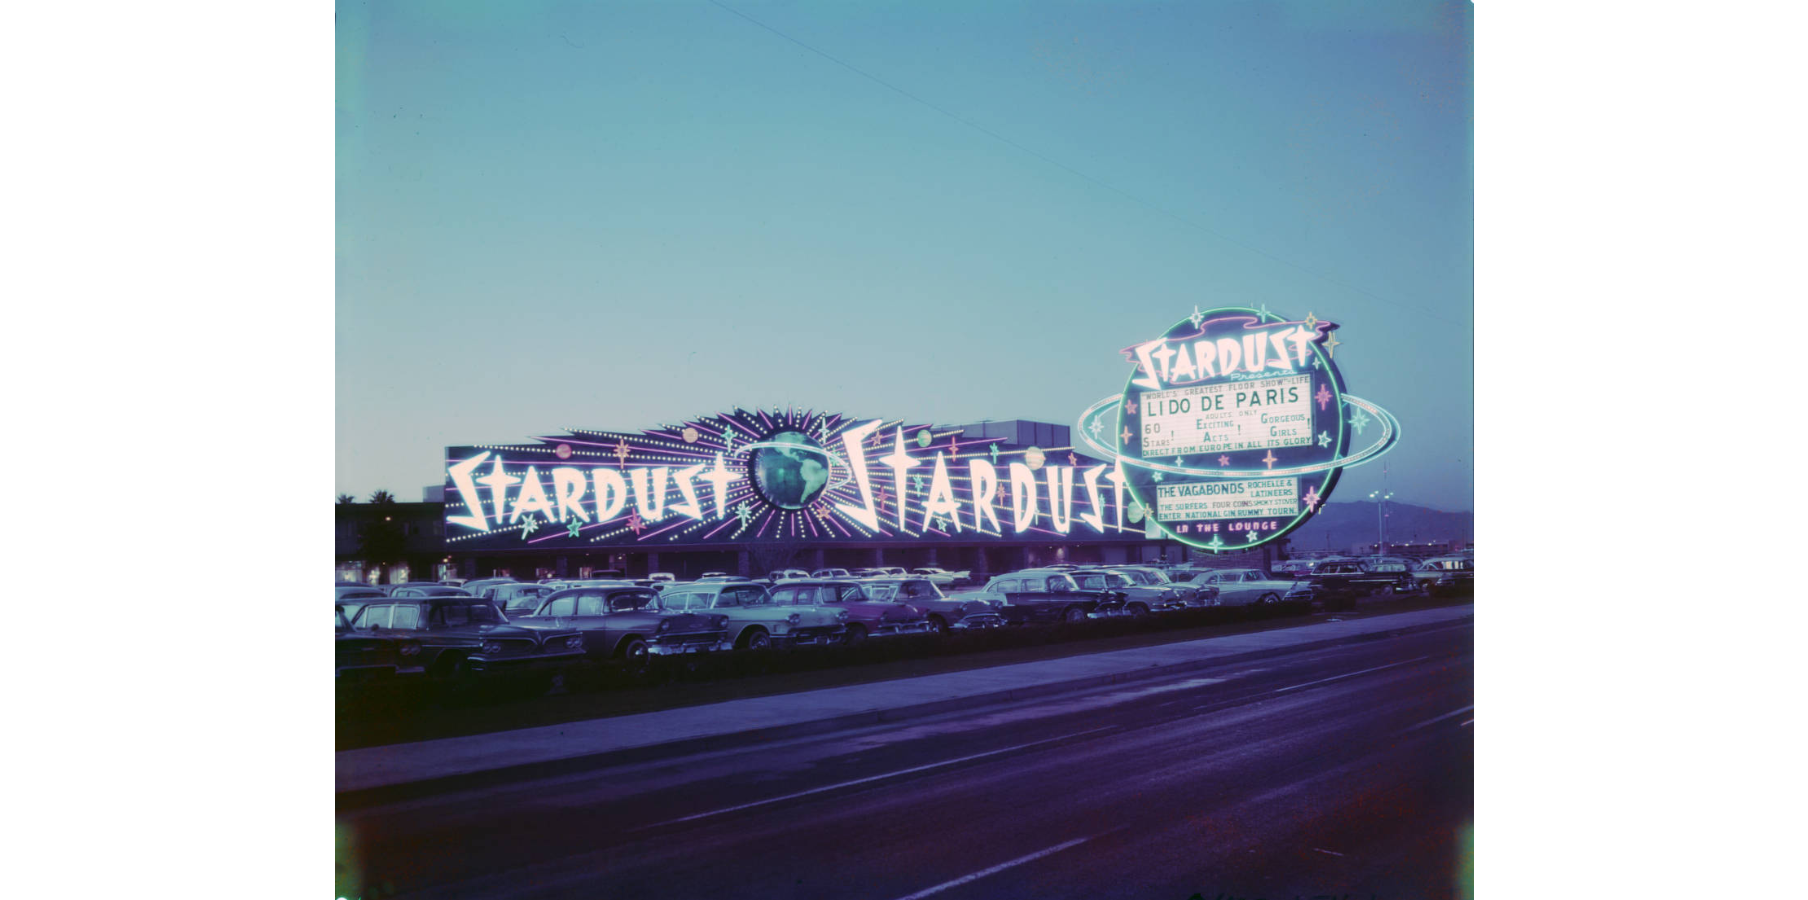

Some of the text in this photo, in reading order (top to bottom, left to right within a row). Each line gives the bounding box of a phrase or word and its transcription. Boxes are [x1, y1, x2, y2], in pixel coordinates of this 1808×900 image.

[1132, 325, 1316, 390] STARDUST
[1230, 368, 1298, 381] Presents
[1184, 385, 1223, 396] GREATEST
[1228, 382, 1255, 391] FLOOR
[1147, 386, 1299, 417] LIDO DE PARIS
[1205, 409, 1258, 420] ADULTS ONLY
[1142, 436, 1311, 457] DIRECT FROM EUROPE IN ALL ITS GLORY
[830, 417, 1127, 534] STARDUST
[446, 449, 744, 532] STARDUST
[1158, 482, 1245, 498] THE VAGABONDS
[1247, 479, 1293, 489] ROCHELLE &
[1250, 488, 1293, 498] LATINEERS
[1160, 502, 1208, 511] THE SURFERS
[1212, 500, 1253, 509] FOUR COINS
[1158, 512, 1181, 521] ENTER
[1185, 510, 1221, 519] NATIONAL
[1223, 509, 1236, 518] GIN
[1237, 508, 1264, 517] RUMMY
[1196, 523, 1219, 533] THE
[1228, 521, 1277, 531] LOUNGE
